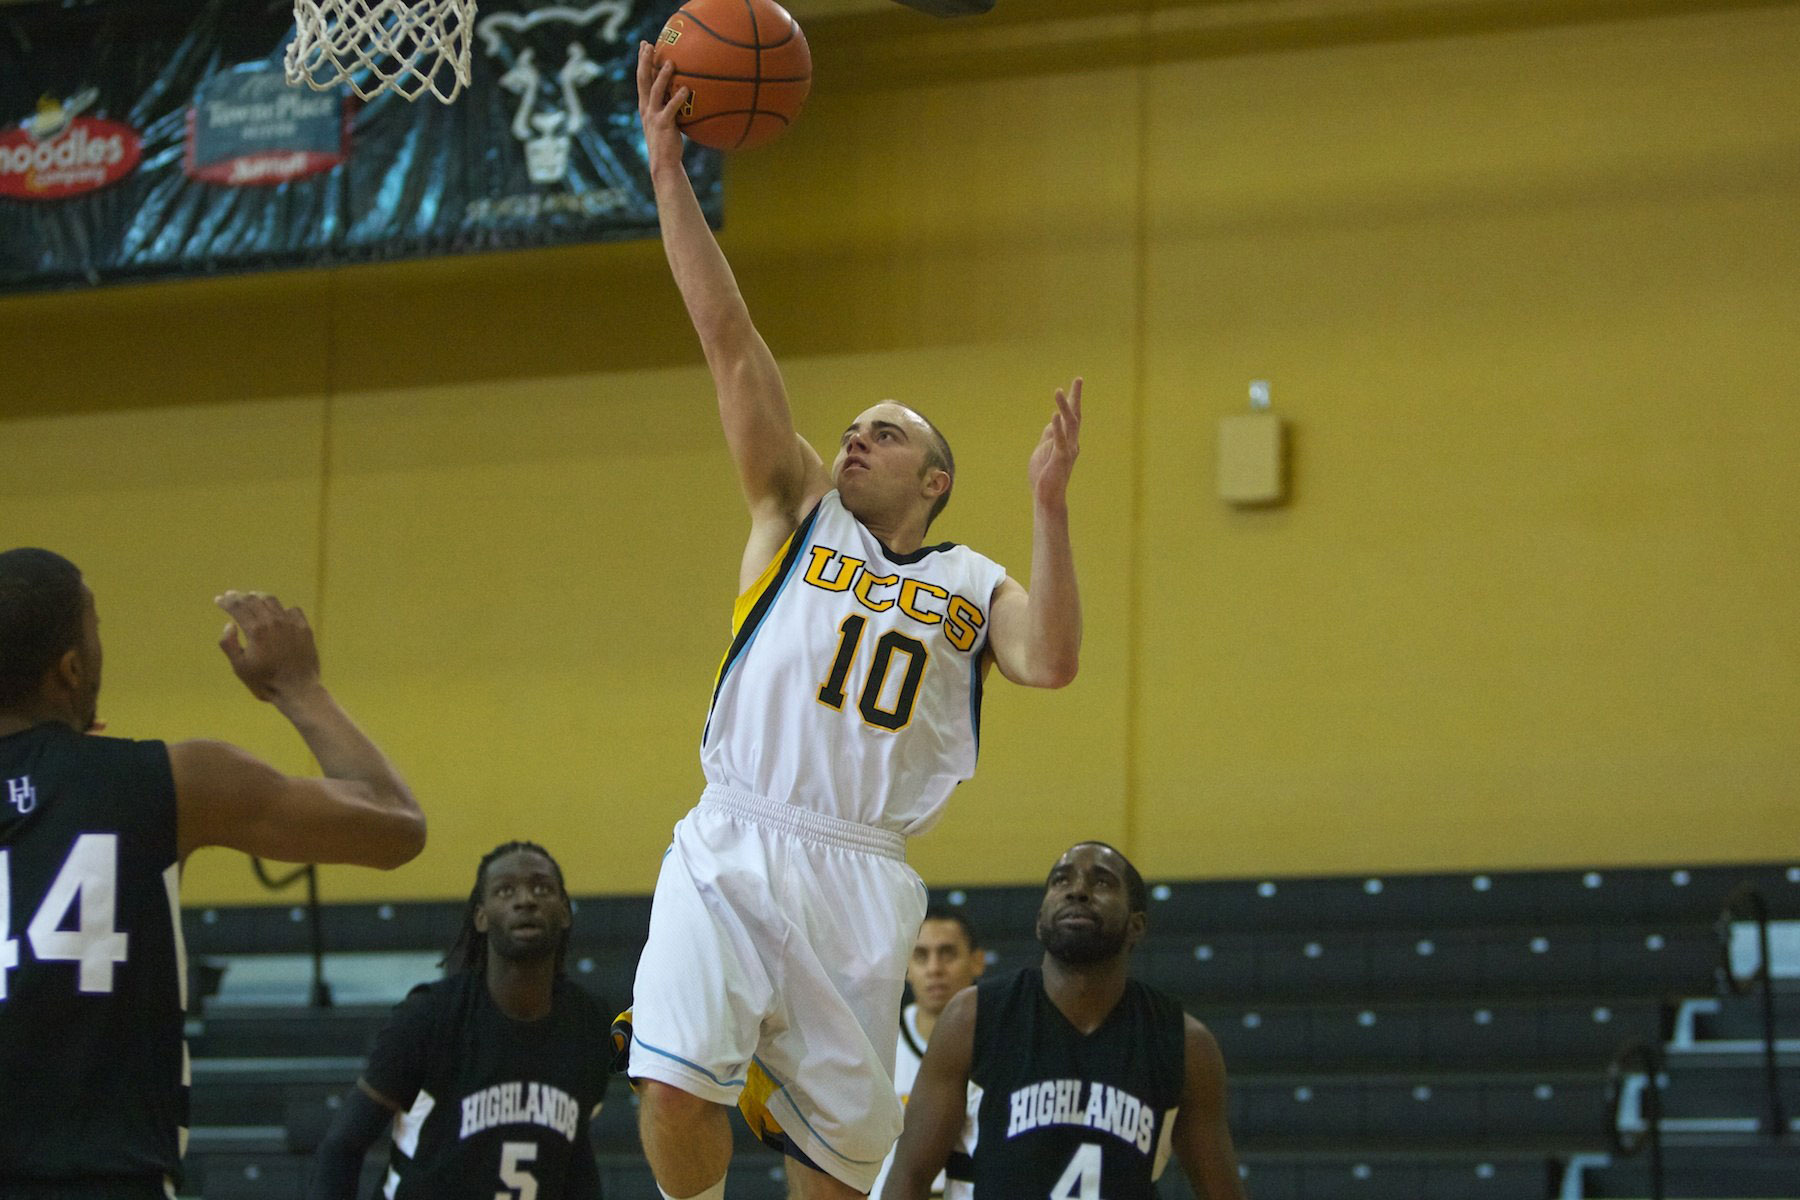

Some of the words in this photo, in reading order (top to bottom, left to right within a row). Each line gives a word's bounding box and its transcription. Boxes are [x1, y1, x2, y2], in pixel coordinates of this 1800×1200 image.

[803, 545, 985, 652] UCCS
[816, 611, 929, 733] 10
[7, 775, 36, 814] HU
[459, 1081, 579, 1142] HIGHLANDS
[1006, 1079, 1154, 1155] HIGHLANDS
[494, 1141, 538, 1200] 5
[1050, 1142, 1102, 1200] 4
